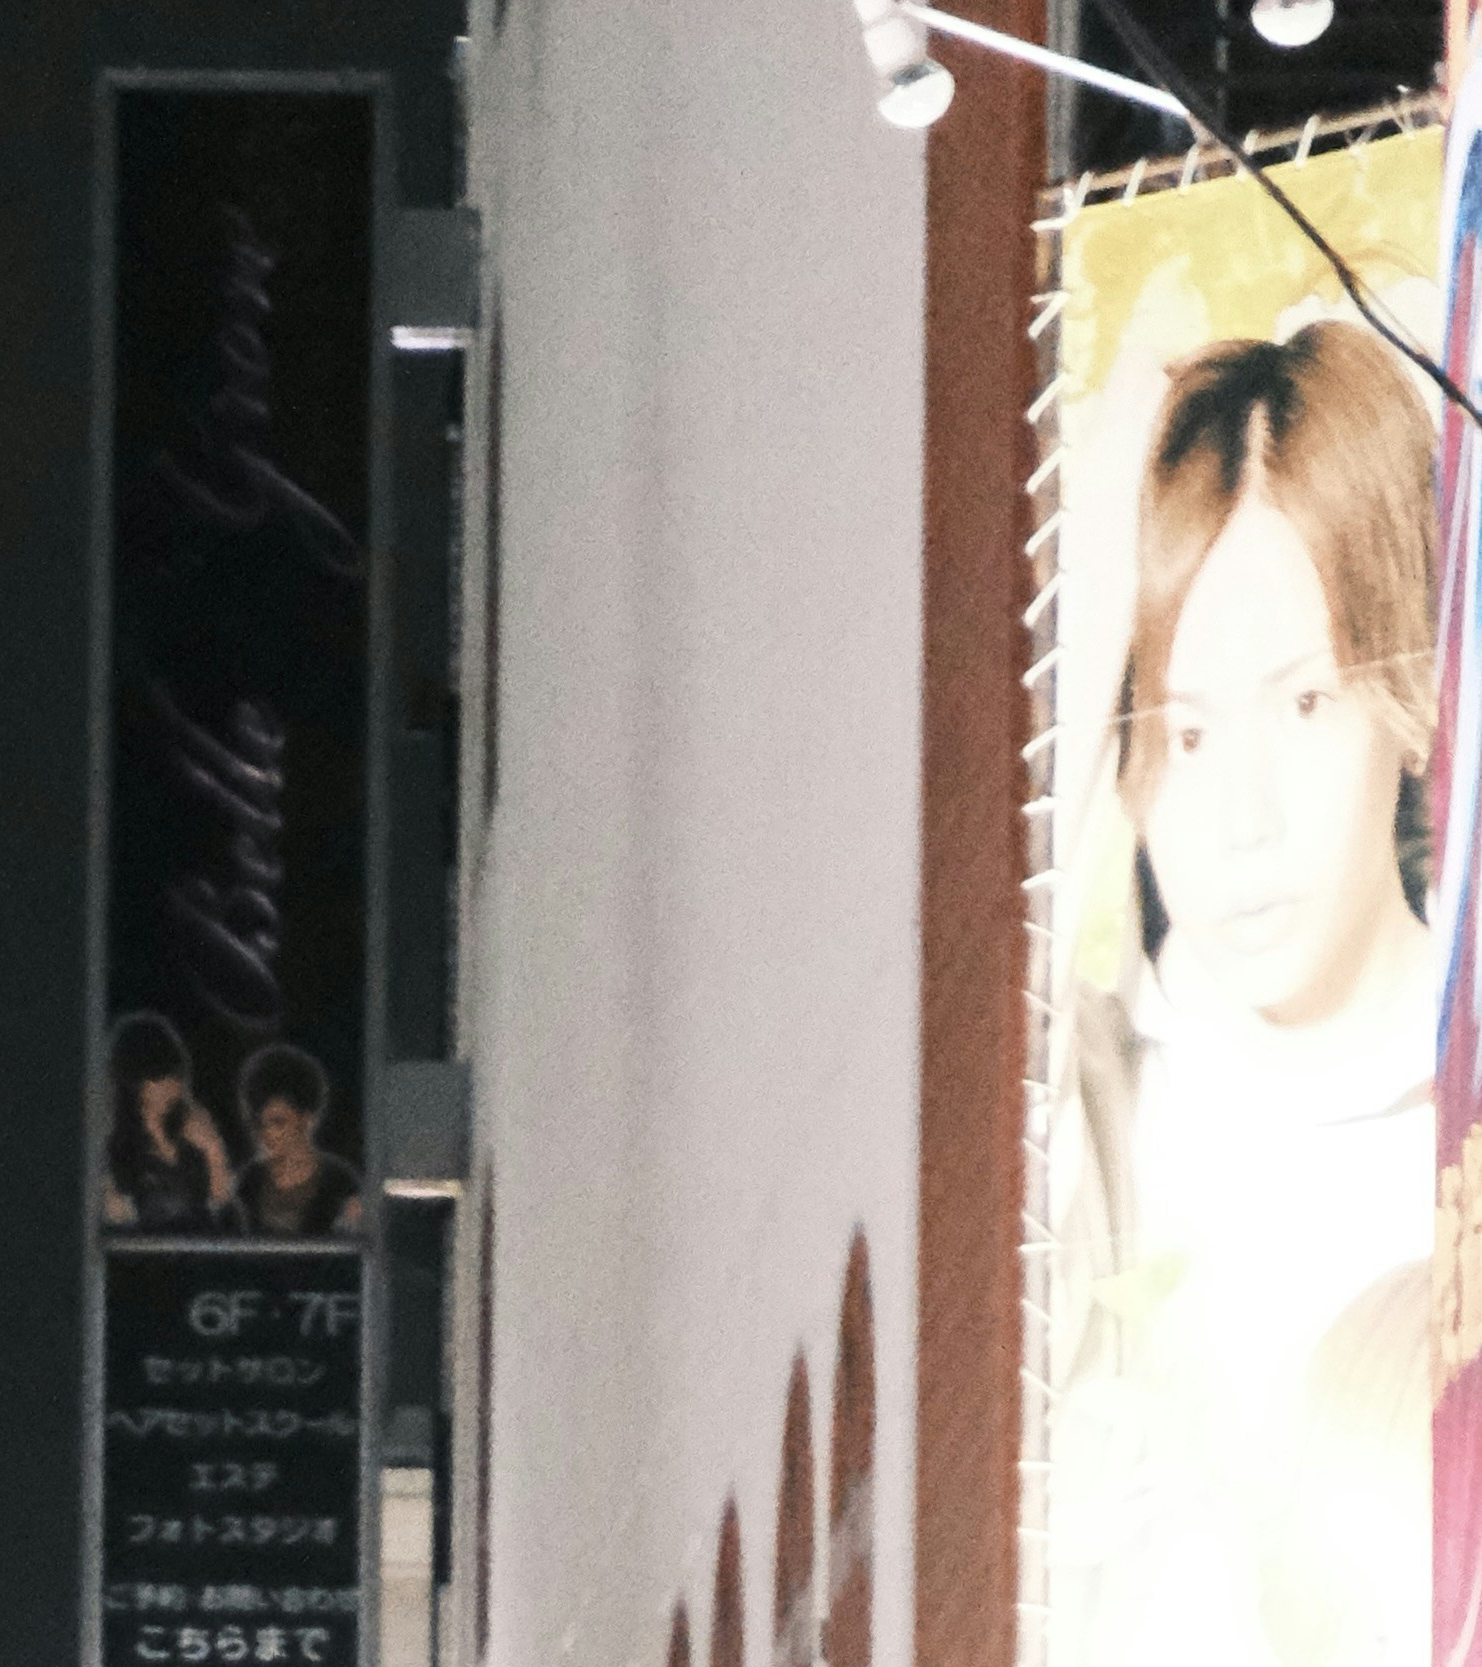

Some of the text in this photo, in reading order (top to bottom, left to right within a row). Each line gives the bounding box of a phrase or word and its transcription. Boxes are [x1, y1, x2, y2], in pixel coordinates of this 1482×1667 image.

[134, 1625, 332, 1662] こちらまで
